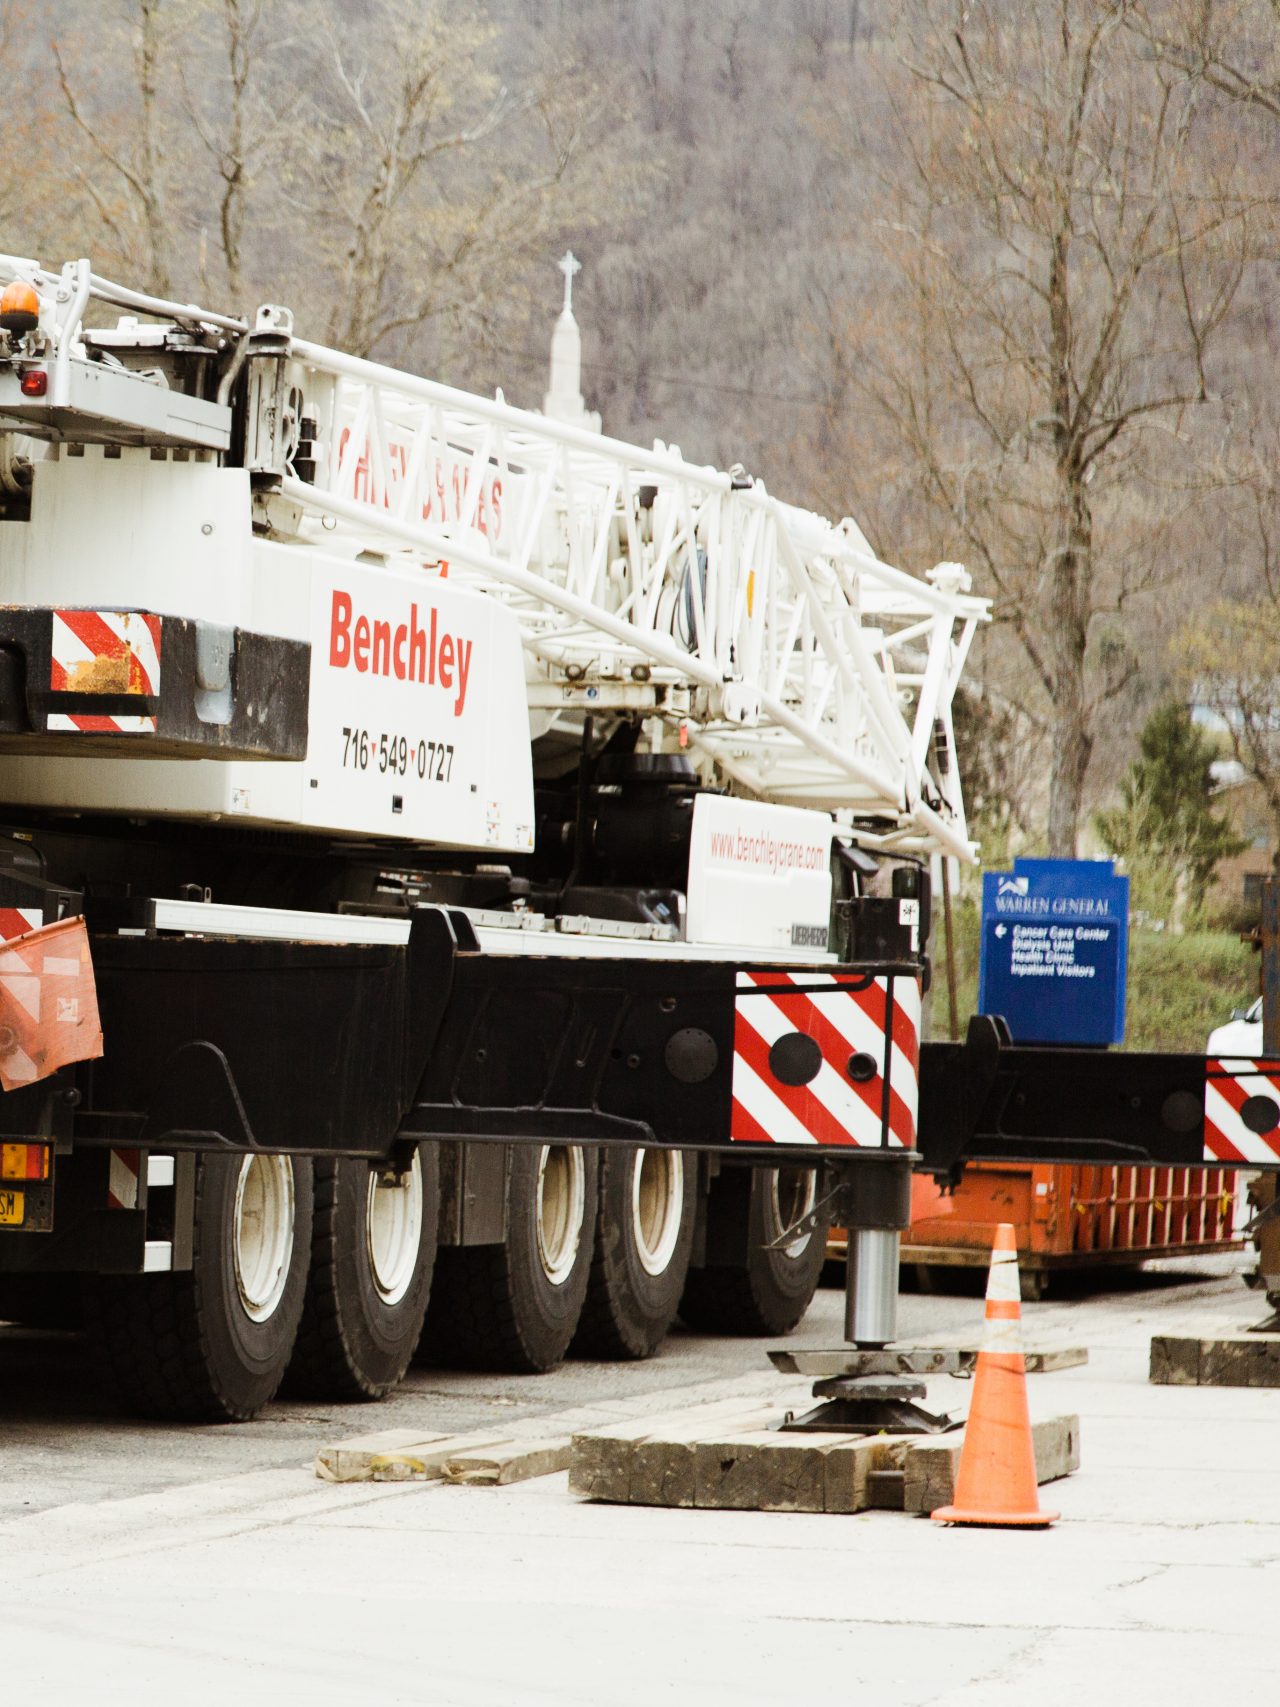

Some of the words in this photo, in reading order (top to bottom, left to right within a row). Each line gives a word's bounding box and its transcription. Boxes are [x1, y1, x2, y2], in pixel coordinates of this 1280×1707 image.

[329, 589, 473, 718] Benchley
[710, 826, 825, 875] www.benchleycrane.com
[995, 896, 1050, 914] WARREN
[1052, 898, 1110, 916] GENERAL
[1012, 924, 1048, 939] Cancer
[1049, 925, 1074, 940] Care
[1075, 926, 1110, 941] Center
[1011, 951, 1044, 964] Health
[1045, 950, 1075, 964] Clinic
[1010, 963, 1055, 977] Inpatient
[1056, 964, 1096, 978] Visitors
